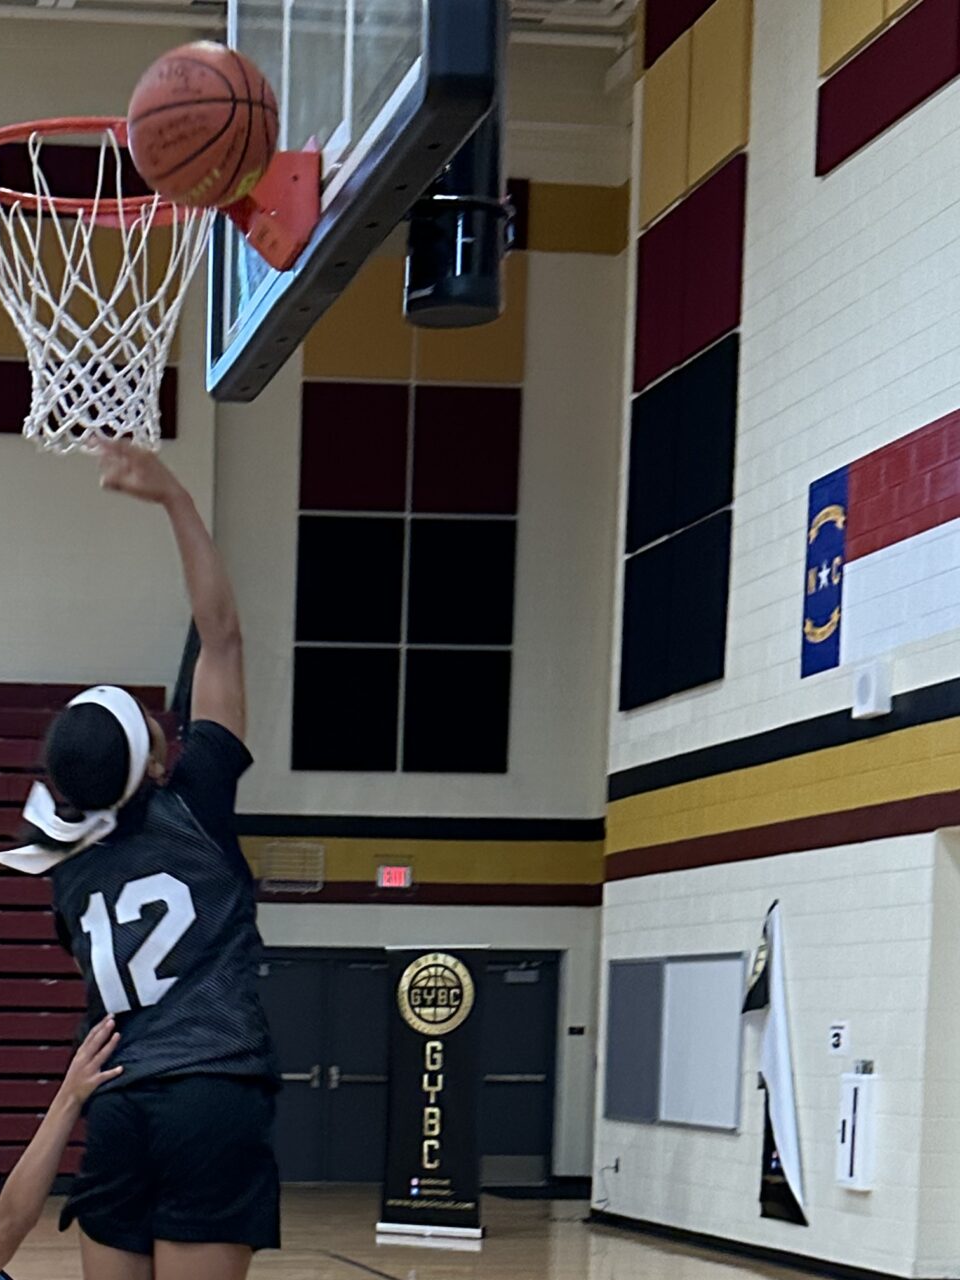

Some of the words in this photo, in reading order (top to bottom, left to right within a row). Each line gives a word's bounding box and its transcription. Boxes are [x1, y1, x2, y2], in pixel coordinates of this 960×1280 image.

[80, 872, 197, 1015] 12
[410, 988, 461, 1006] GYBC
[831, 1031, 841, 1049] 3
